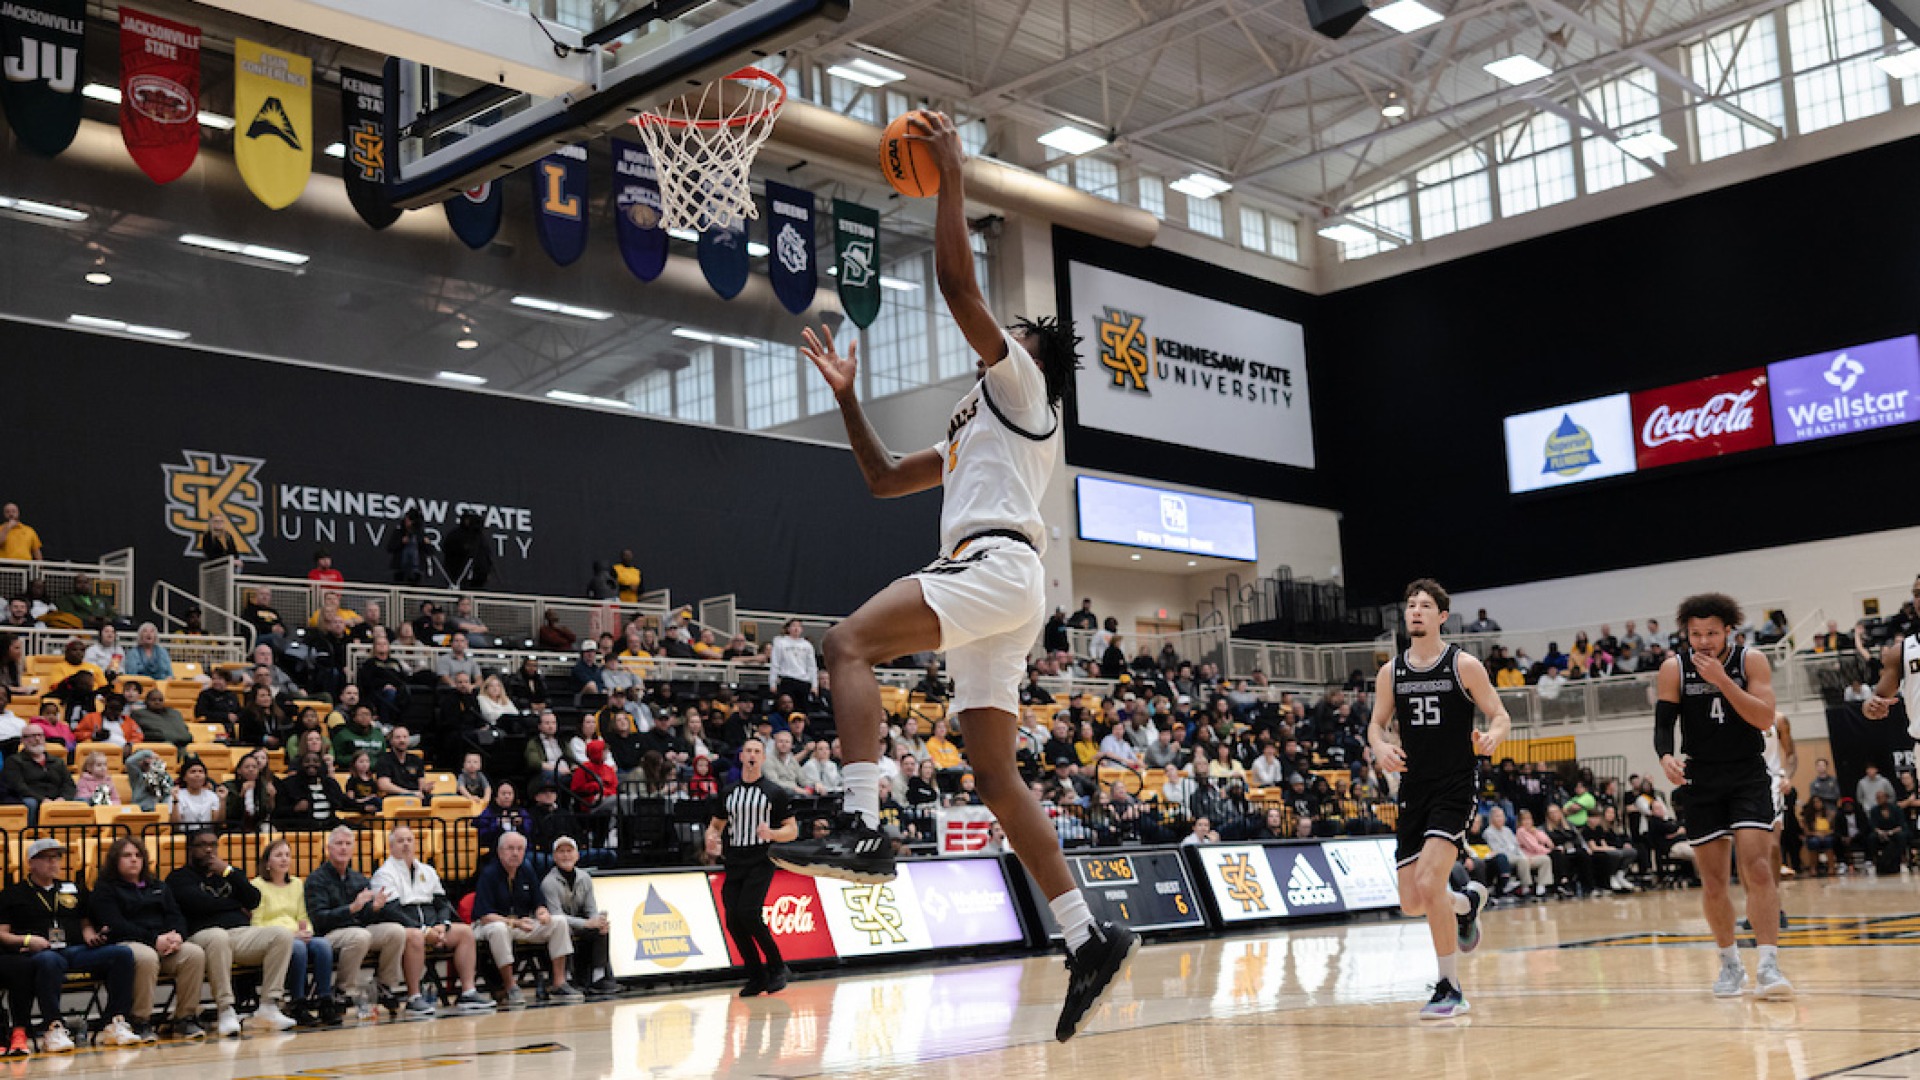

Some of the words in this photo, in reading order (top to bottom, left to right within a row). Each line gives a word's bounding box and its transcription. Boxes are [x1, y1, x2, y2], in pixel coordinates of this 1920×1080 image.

[1, 2, 85, 35] JACKSONVILLE
[121, 16, 200, 50] JACKSONVILLE
[3, 36, 78, 93] JU
[145, 38, 178, 60] STATE
[240, 60, 307, 87] CONFERENCE
[341, 77, 383, 97] KENNE
[357, 95, 384, 114] STA
[888, 138, 905, 180] NCAA
[1156, 337, 1245, 375] KENNESAW
[1250, 361, 1292, 387] STATE
[1157, 362, 1293, 409] UNIVERSITY
[1642, 389, 1757, 447] Coca-Cola
[1788, 389, 1909, 427] Wellstar
[1796, 421, 1847, 439] HEALTH
[1853, 411, 1906, 429] SYSTEM
[280, 483, 448, 525] KENNESAW
[281, 514, 533, 559] UNIVRTY
[1408, 695, 1441, 726] 35
[1709, 697, 1725, 724] 4
[1893, 751, 1916, 766] PR
[945, 821, 991, 852] ES
[1087, 857, 1132, 880] 12:46
[1173, 894, 1189, 915] 6
